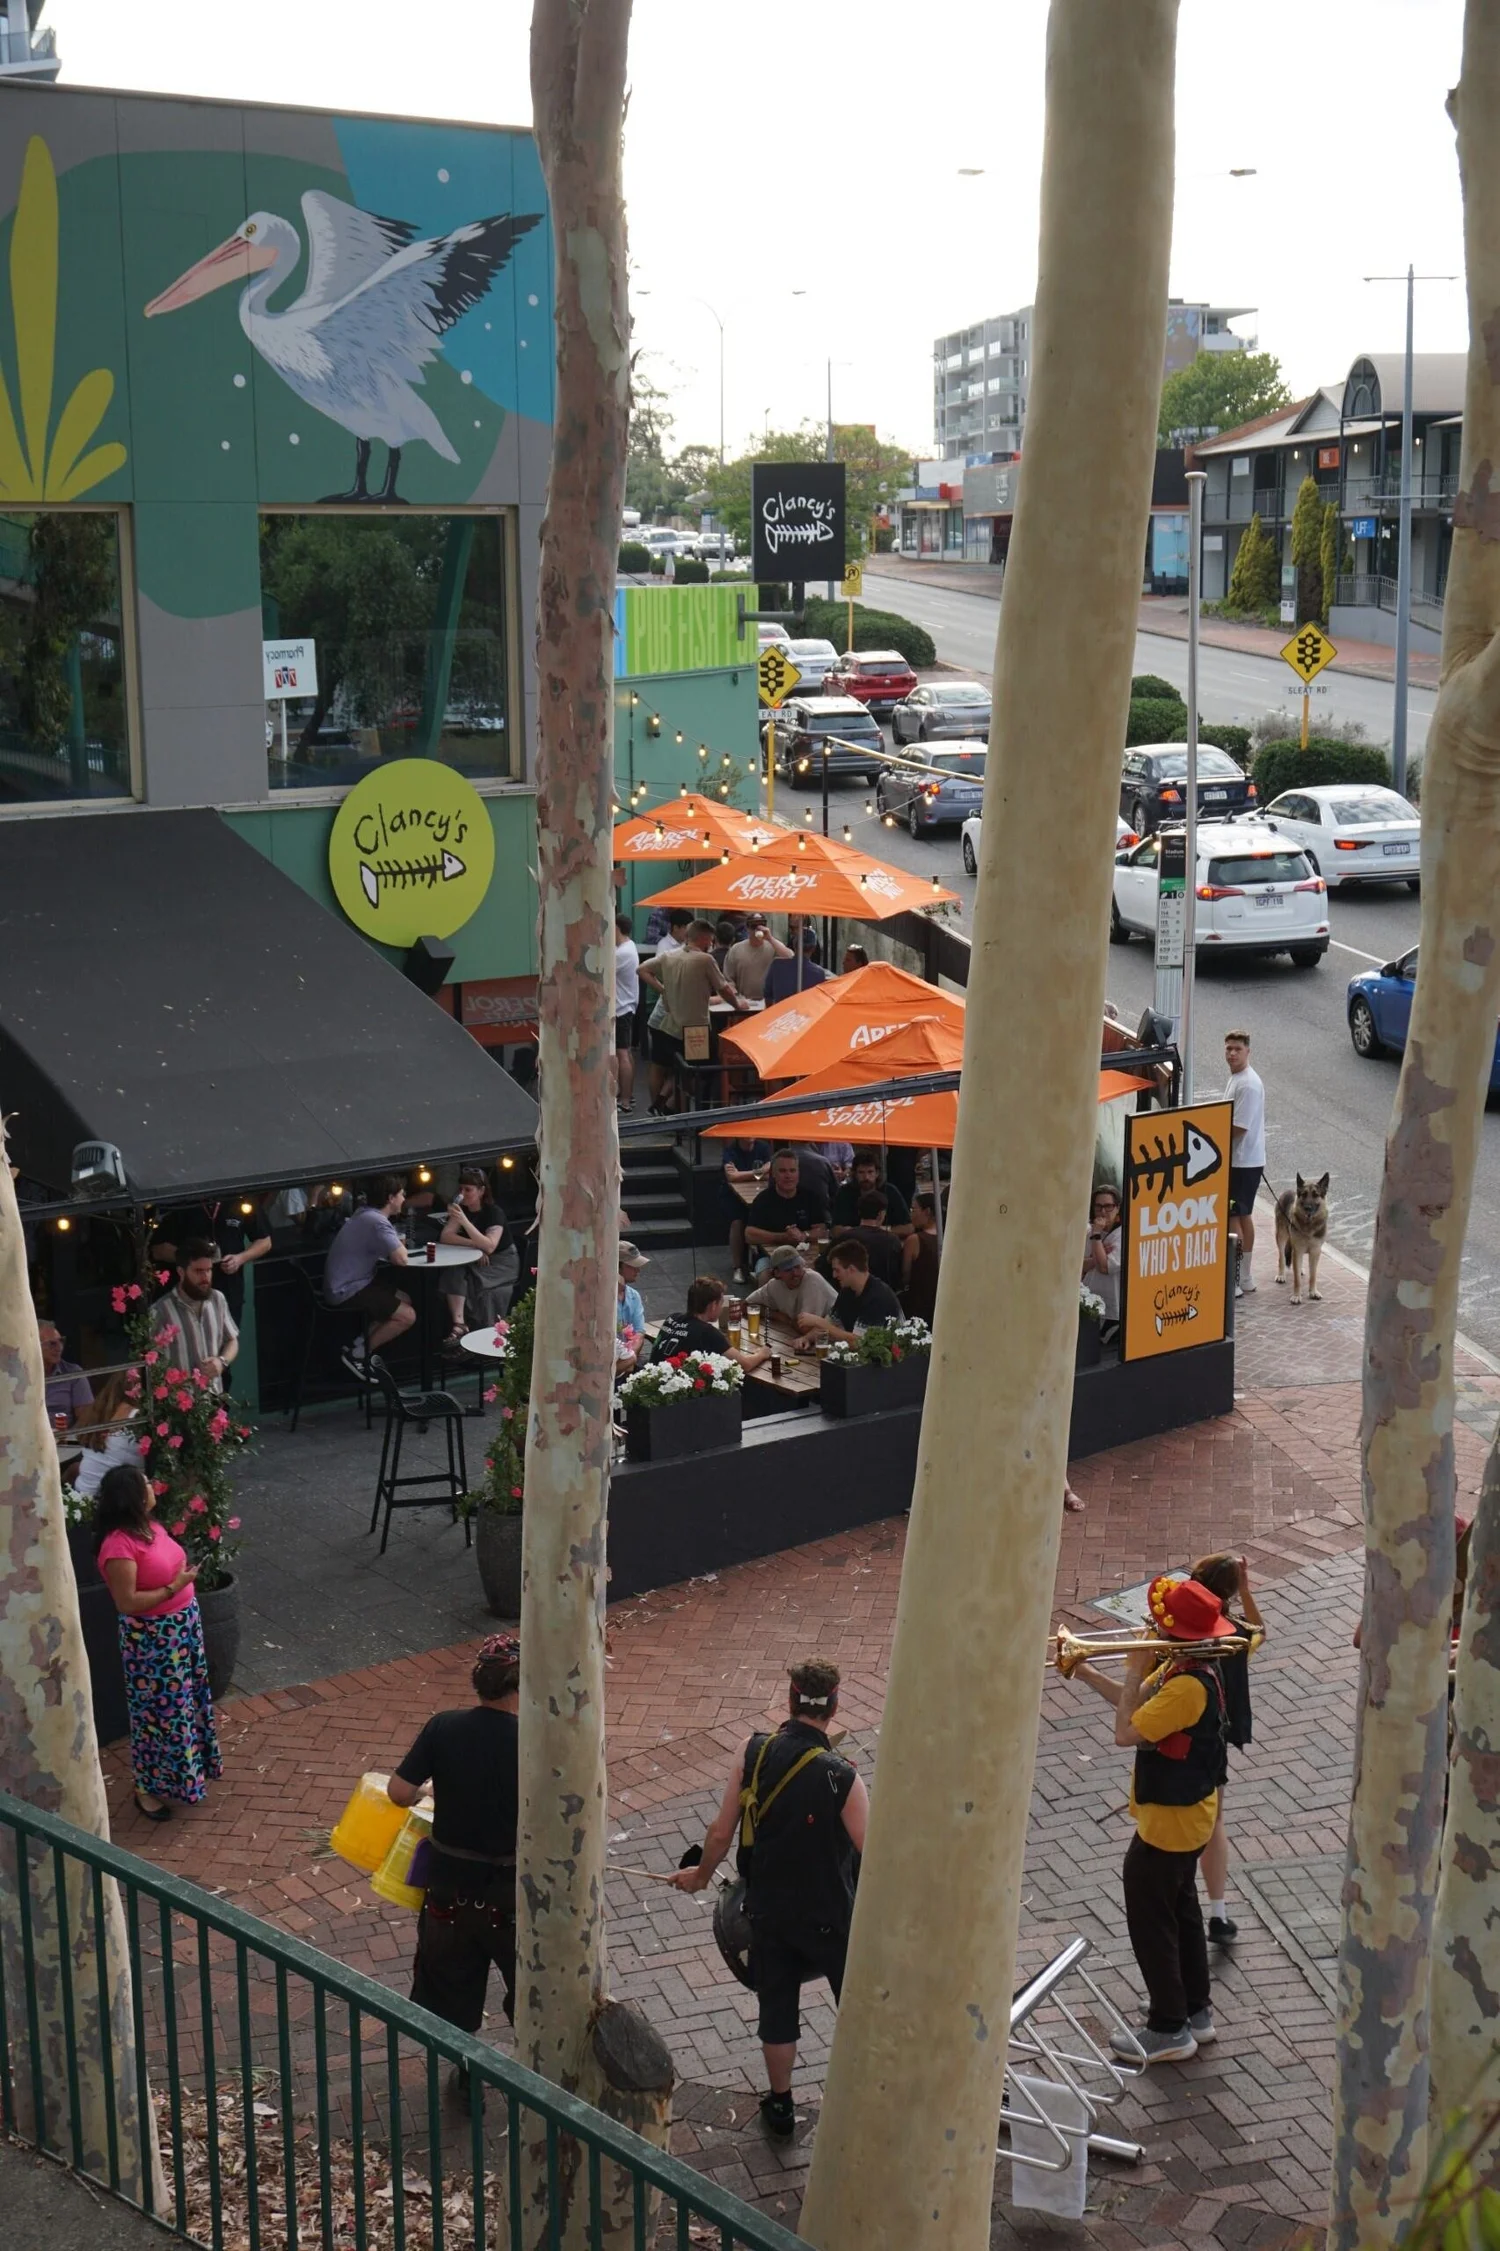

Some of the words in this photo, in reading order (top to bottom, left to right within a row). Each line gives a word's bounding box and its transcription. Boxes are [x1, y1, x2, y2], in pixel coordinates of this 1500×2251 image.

[762, 492, 836, 522] Clancy's
[633, 588, 671, 676] PUB
[678, 587, 718, 669] FISH
[1288, 686, 1313, 695] SLEAT
[1316, 685, 1327, 694] RD
[354, 803, 468, 855] Clancy's
[624, 829, 698, 849] APROL
[631, 840, 685, 852] SPRITZ
[728, 874, 818, 892] APEROL
[737, 885, 801, 900] SPRITZ
[819, 1108, 895, 1126] SPRITZ
[1139, 1193, 1219, 1236] LOOK
[1139, 1235, 1181, 1278] WHO'S
[1185, 1227, 1218, 1269] BACK
[1153, 1284, 1200, 1310] Clancy's
